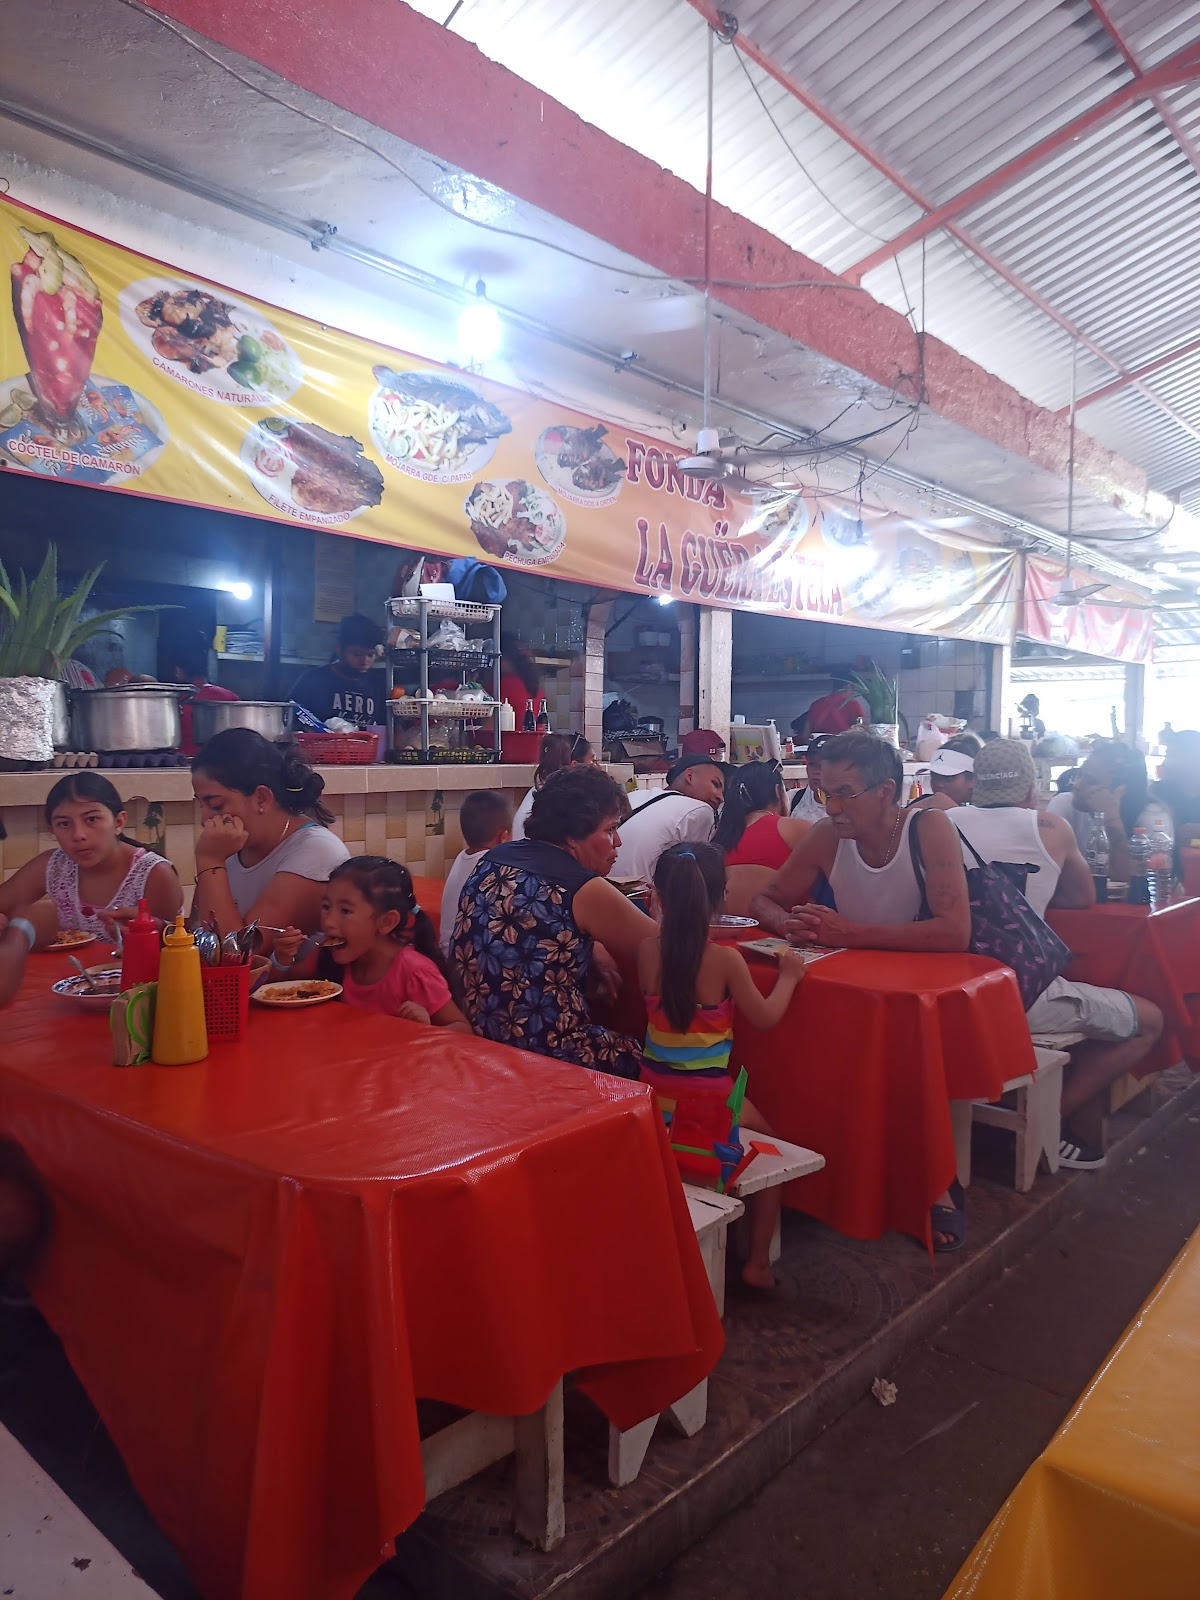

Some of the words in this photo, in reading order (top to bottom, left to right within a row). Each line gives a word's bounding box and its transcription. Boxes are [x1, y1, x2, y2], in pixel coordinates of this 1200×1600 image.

[152, 357, 214, 397] CAMARONES
[217, 390, 271, 403] NATURAL
[8, 440, 59, 460] COCTEL
[62, 451, 79, 463] DE
[385, 453, 421, 478] MOJARRA
[450, 471, 472, 483] PAPAS
[269, 494, 298, 517] FILETE
[299, 512, 350, 525] EMPANIZADO
[505, 552, 536, 566] PECHUGA
[633, 518, 673, 592] LA
[332, 692, 374, 715] AERO
